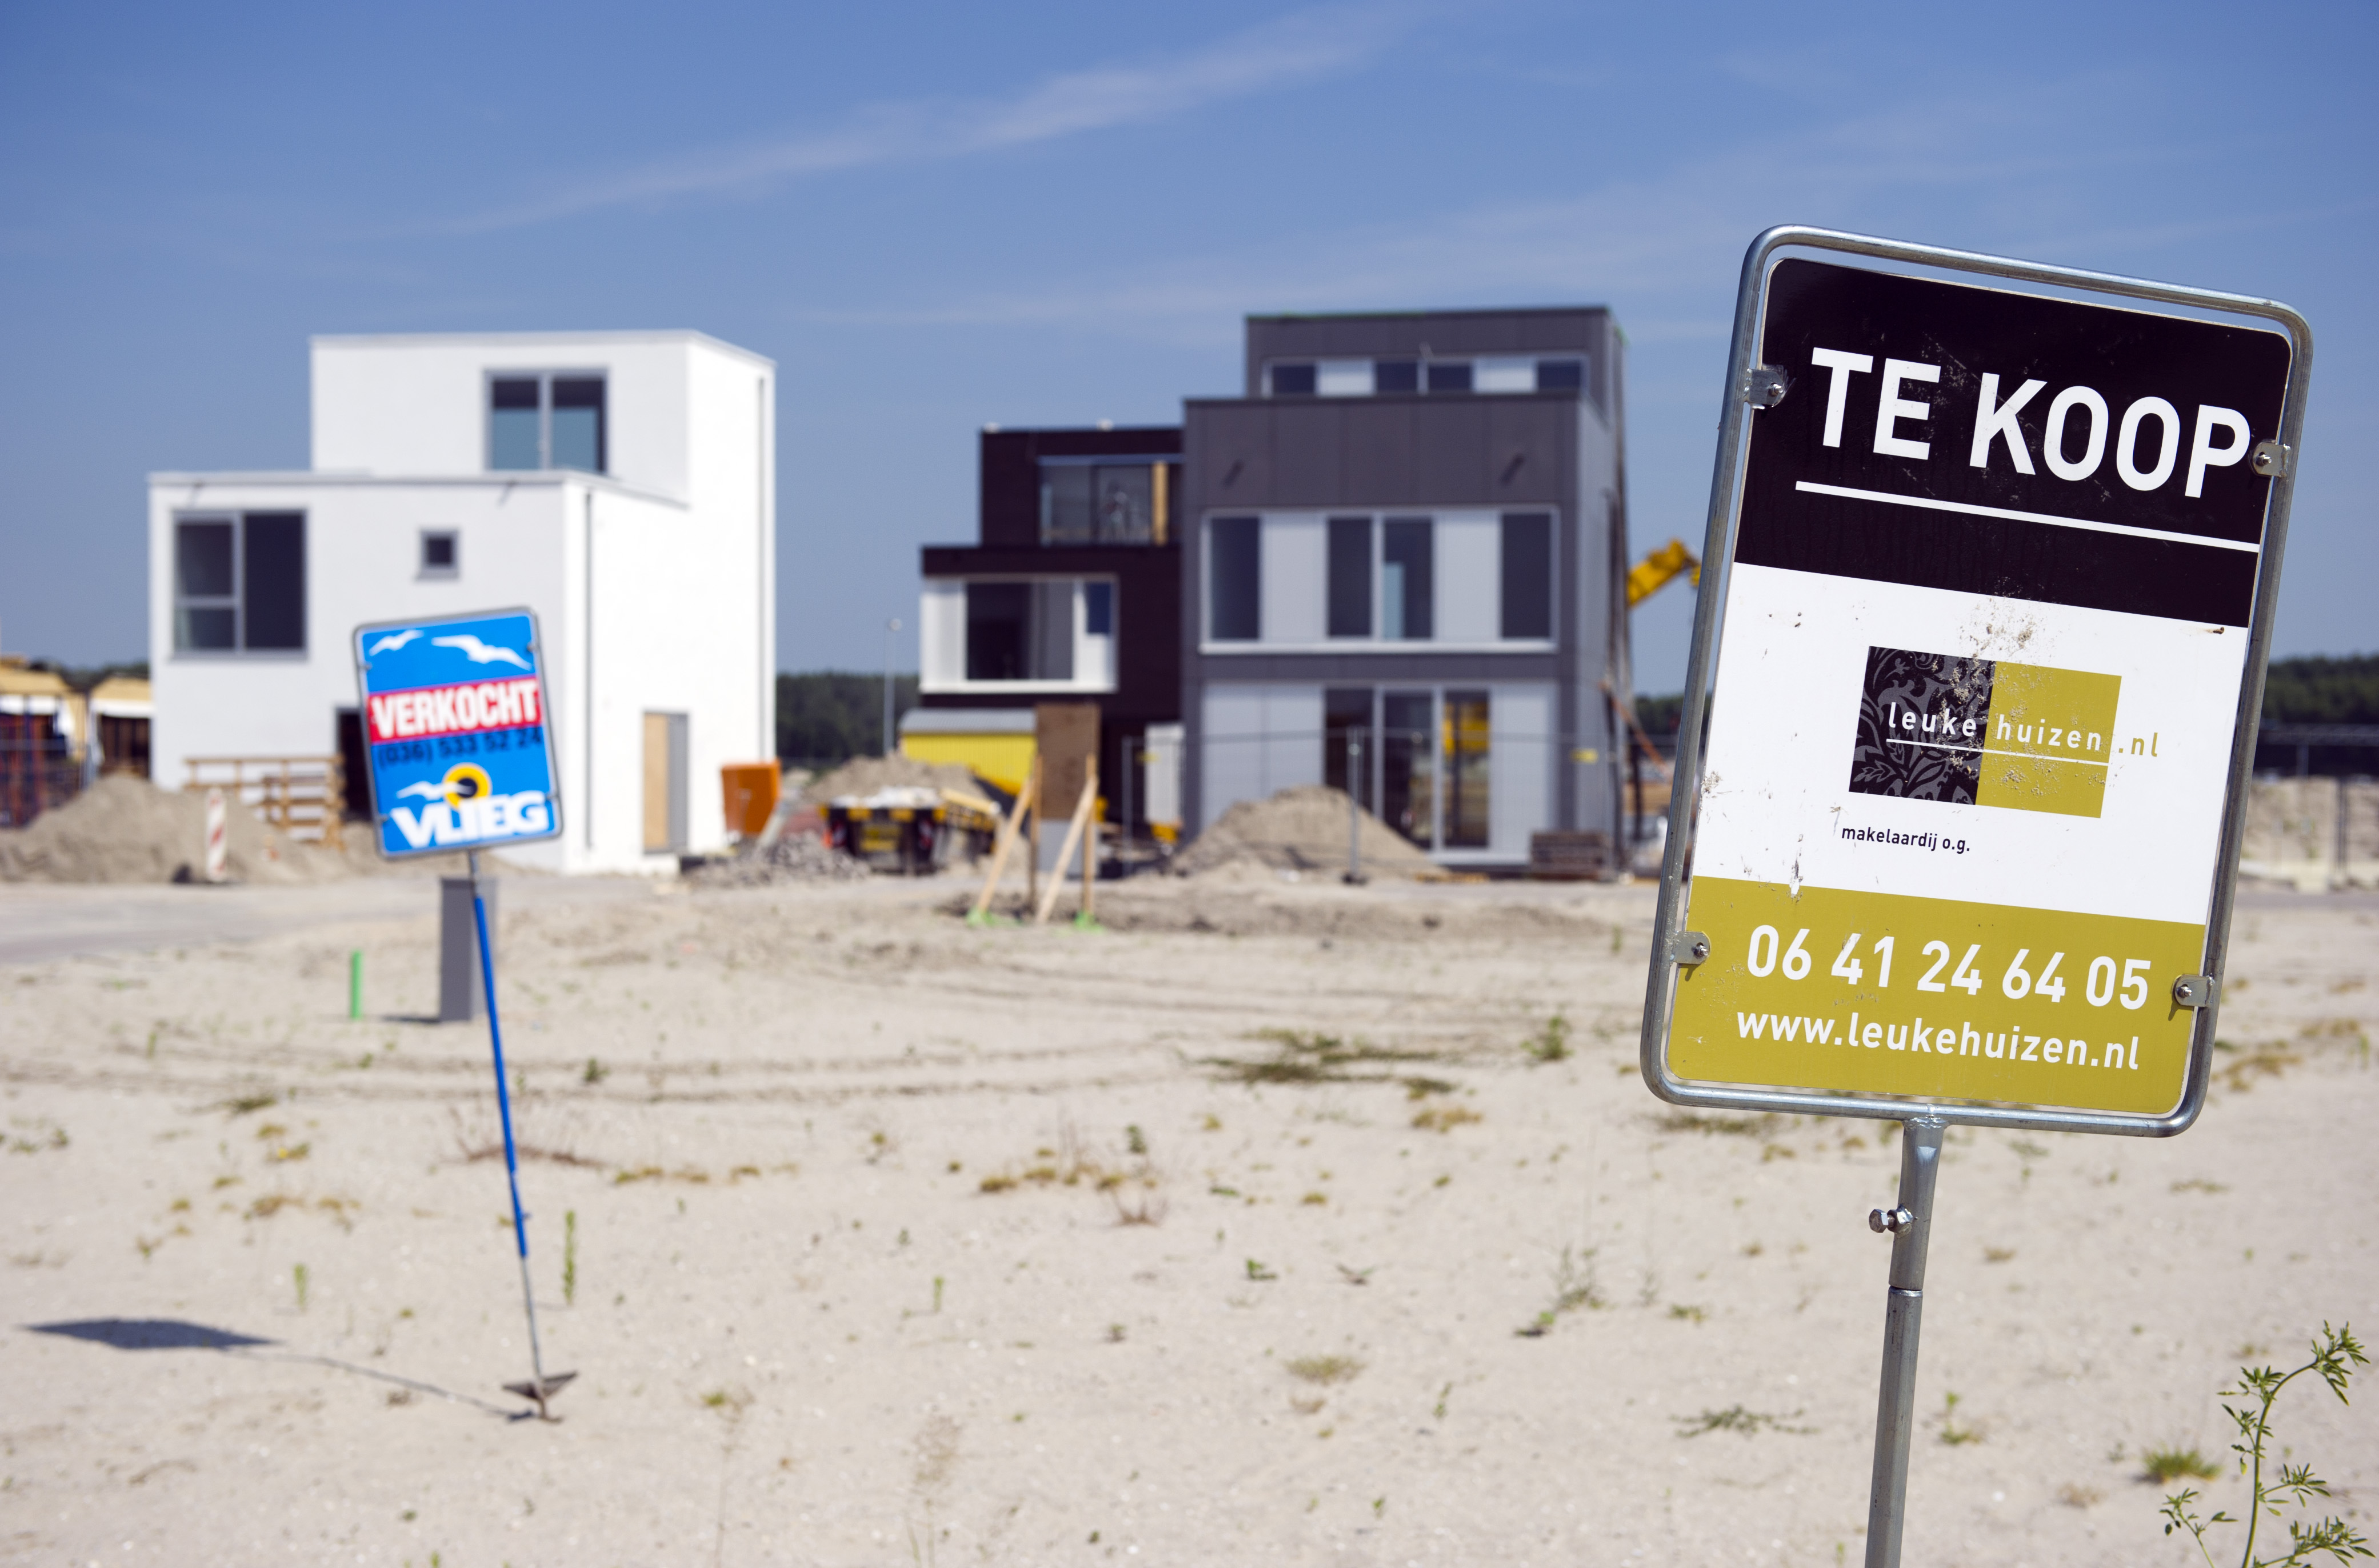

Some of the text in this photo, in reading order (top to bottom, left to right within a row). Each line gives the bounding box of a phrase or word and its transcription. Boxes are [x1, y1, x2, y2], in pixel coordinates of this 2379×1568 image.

[1812, 347, 2250, 499] TE KOOP
[371, 679, 538, 738] VERKOCHT
[1889, 702, 1977, 738] leuke
[390, 790, 549, 848] VLIEG
[1841, 826, 1971, 854] makelaardij o.g.
[1747, 925, 2151, 1010] 06 41 24 64 05
[1737, 1012, 2139, 1070] www.leukehuizen.nl
